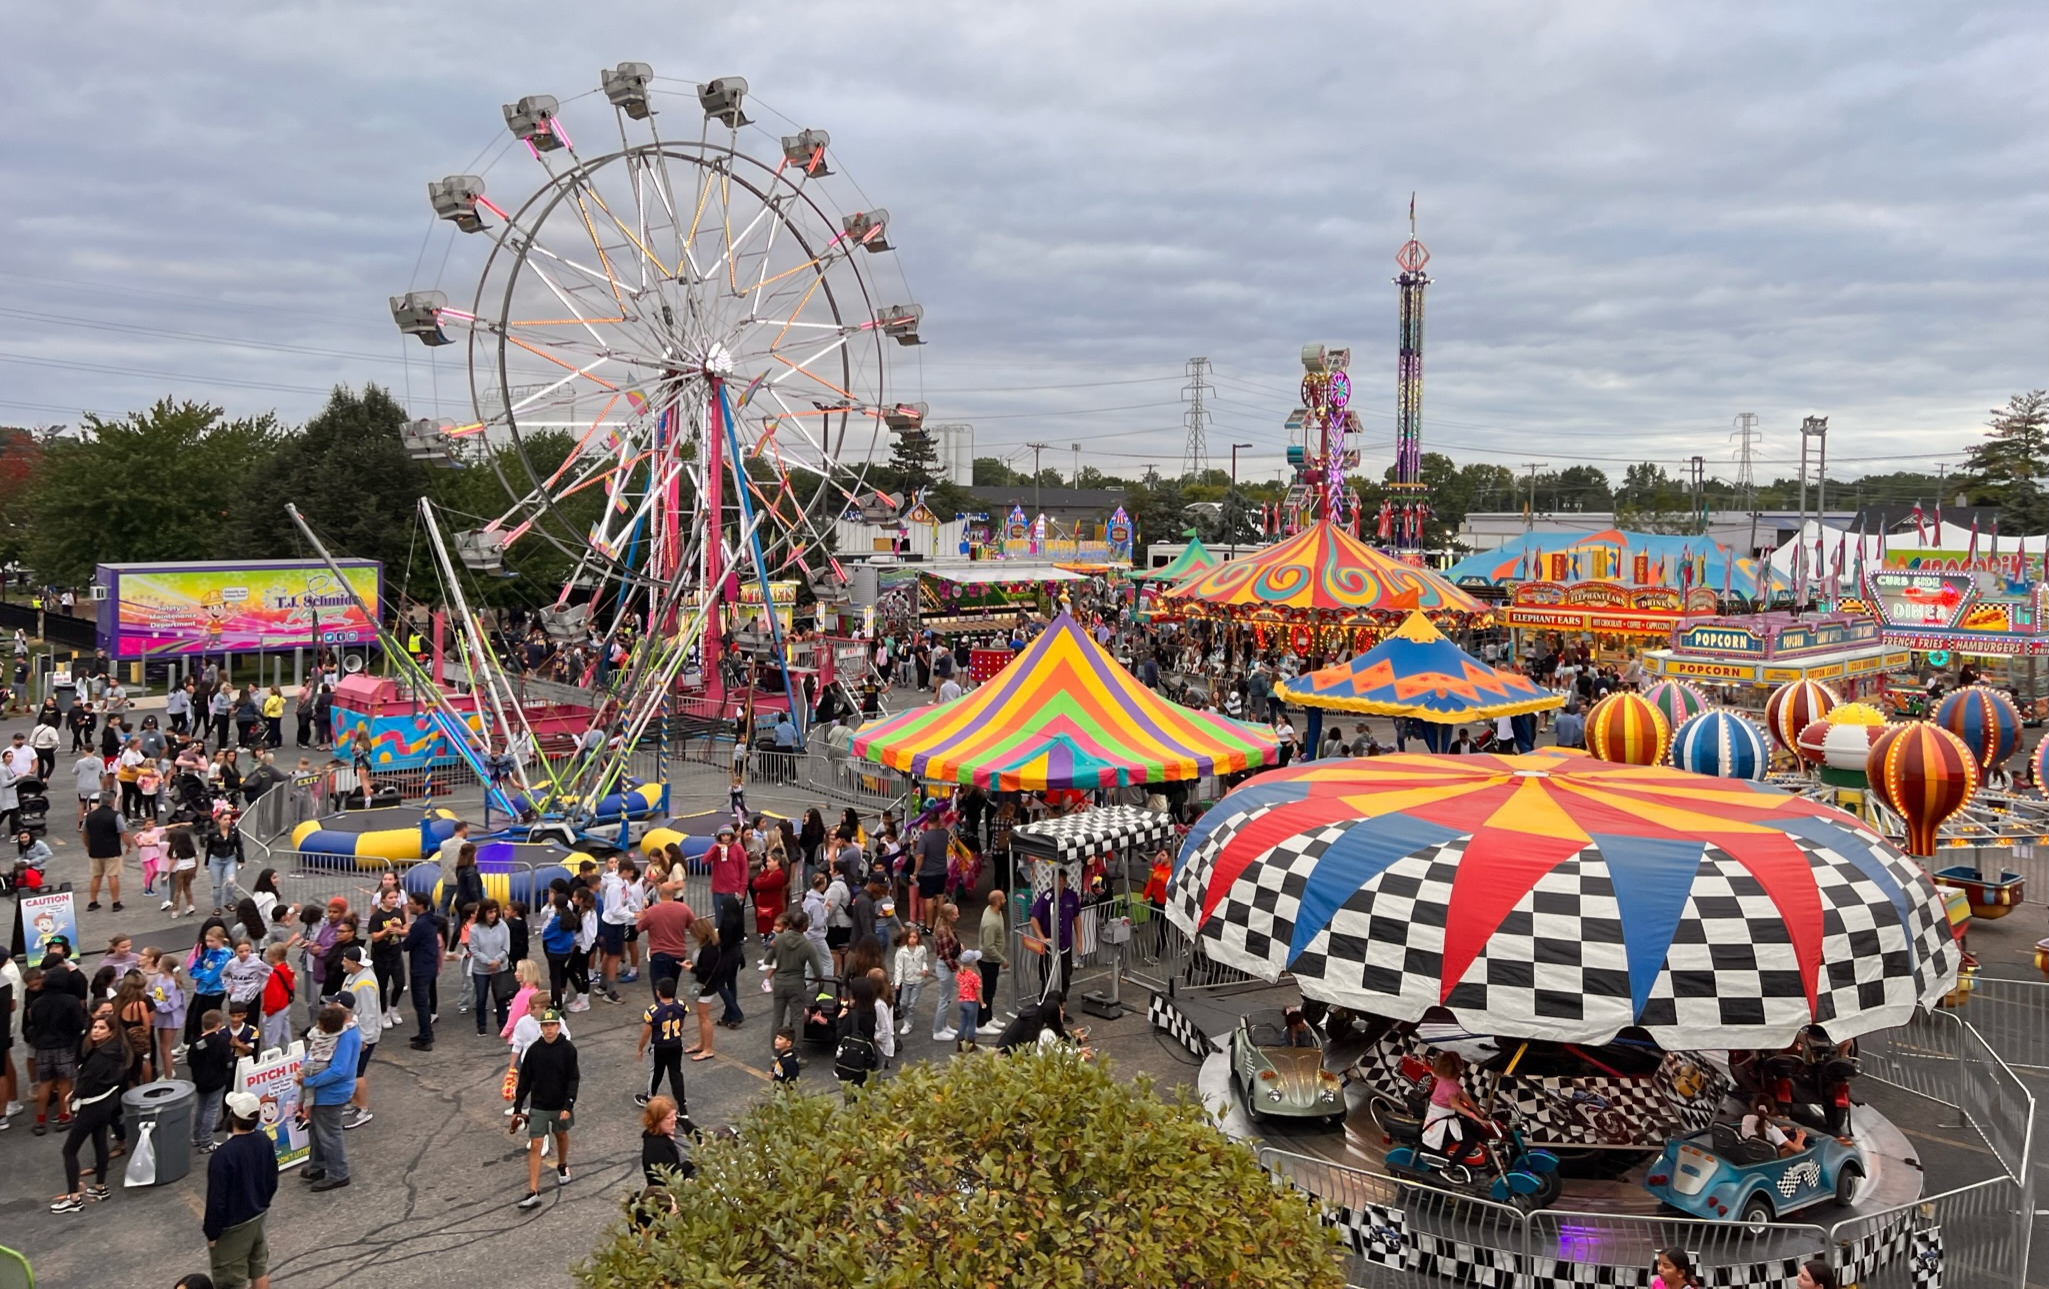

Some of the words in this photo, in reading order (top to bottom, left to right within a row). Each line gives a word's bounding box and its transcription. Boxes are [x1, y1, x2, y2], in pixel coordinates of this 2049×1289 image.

[1877, 575, 1909, 586] CURB
[1913, 577, 1940, 588] SIDE
[277, 596, 299, 608] T.J.
[303, 594, 358, 607] Schmid
[752, 587, 794, 602] TIKETS
[1570, 592, 1604, 603] ELEPHANT
[1606, 592, 1625, 606] EARS
[1641, 600, 1673, 609] DRINKS
[1893, 602, 1947, 619] DINER
[150, 620, 196, 629] Department
[1512, 613, 1556, 624] ELEPHANT
[1557, 616, 1581, 625] EARS
[1695, 632, 1747, 649] POPCORN
[1783, 633, 1804, 649] POPCORN
[1882, 636, 1916, 647] FRENCH
[1918, 638, 1944, 649] FRIES
[1956, 640, 2021, 654] HAMBURGERS
[2035, 647, 2049, 655] DRI
[1679, 664, 1740, 677] POPCORN
[1808, 668, 1825, 679] COTTON
[1886, 655, 1905, 665] POPCORN
[297, 776, 319, 787] EXIT
[25, 894, 69, 907] CAUTION
[247, 1066, 286, 1087] PITCH
